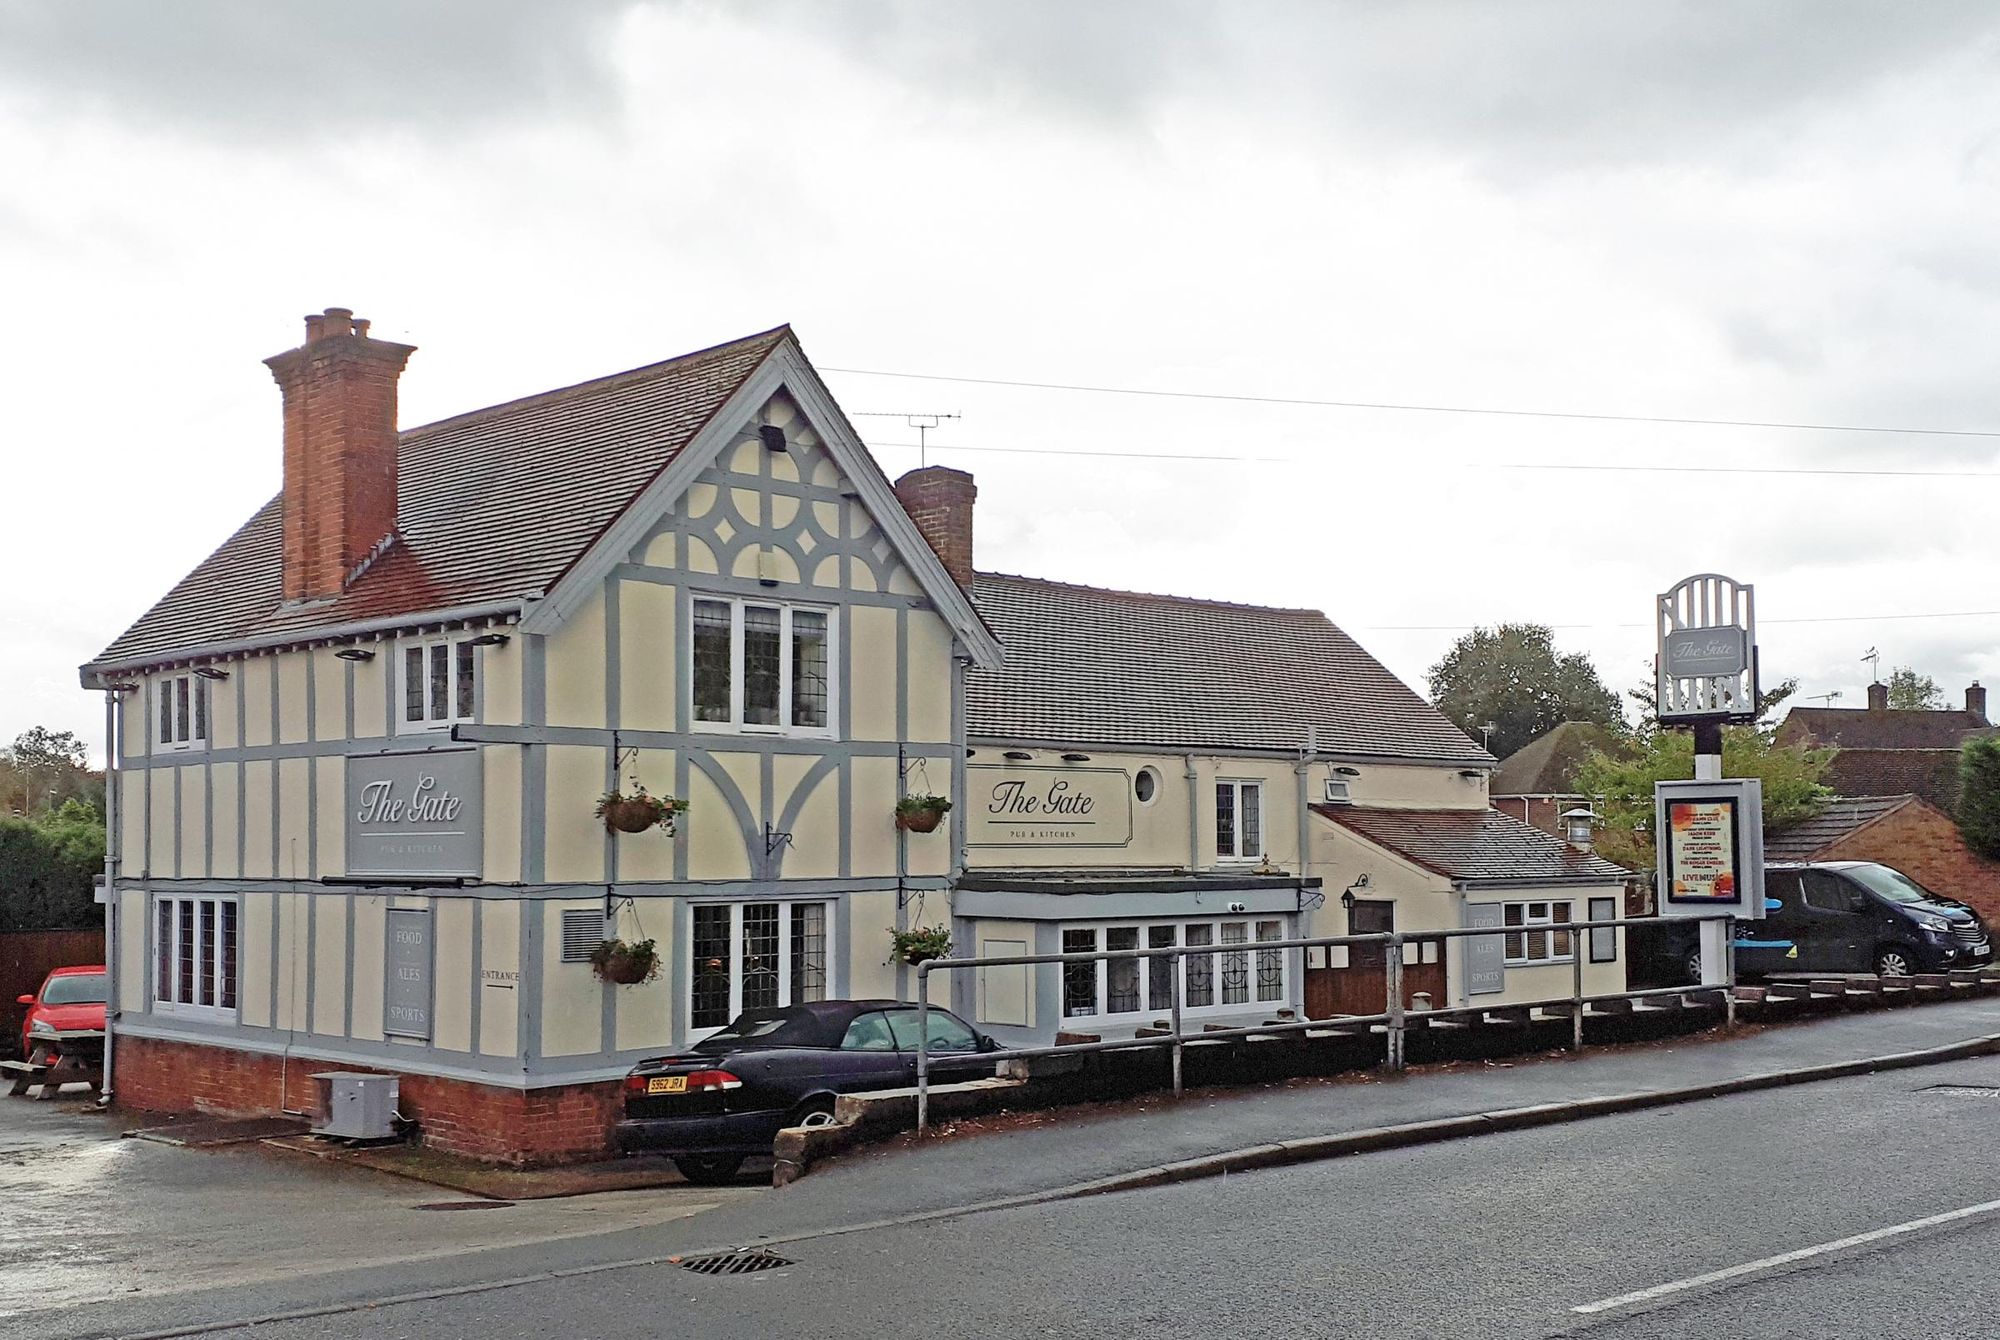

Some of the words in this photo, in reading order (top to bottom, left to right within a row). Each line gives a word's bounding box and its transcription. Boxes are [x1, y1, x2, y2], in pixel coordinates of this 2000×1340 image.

[1673, 641, 1700, 658] The
[1702, 640, 1733, 657] Gate
[358, 779, 405, 823] The
[407, 771, 463, 823] Gate
[989, 780, 1040, 814] The
[1042, 777, 1095, 814] Gate
[1682, 874, 1699, 882] LIVE
[1474, 918, 1494, 928] FOOD
[396, 930, 423, 945] FOOD
[398, 967, 421, 982] ALES
[481, 970, 520, 981] ENTRANCE
[1472, 971, 1499, 983] SPORTS
[390, 1006, 425, 1022] SPORTS
